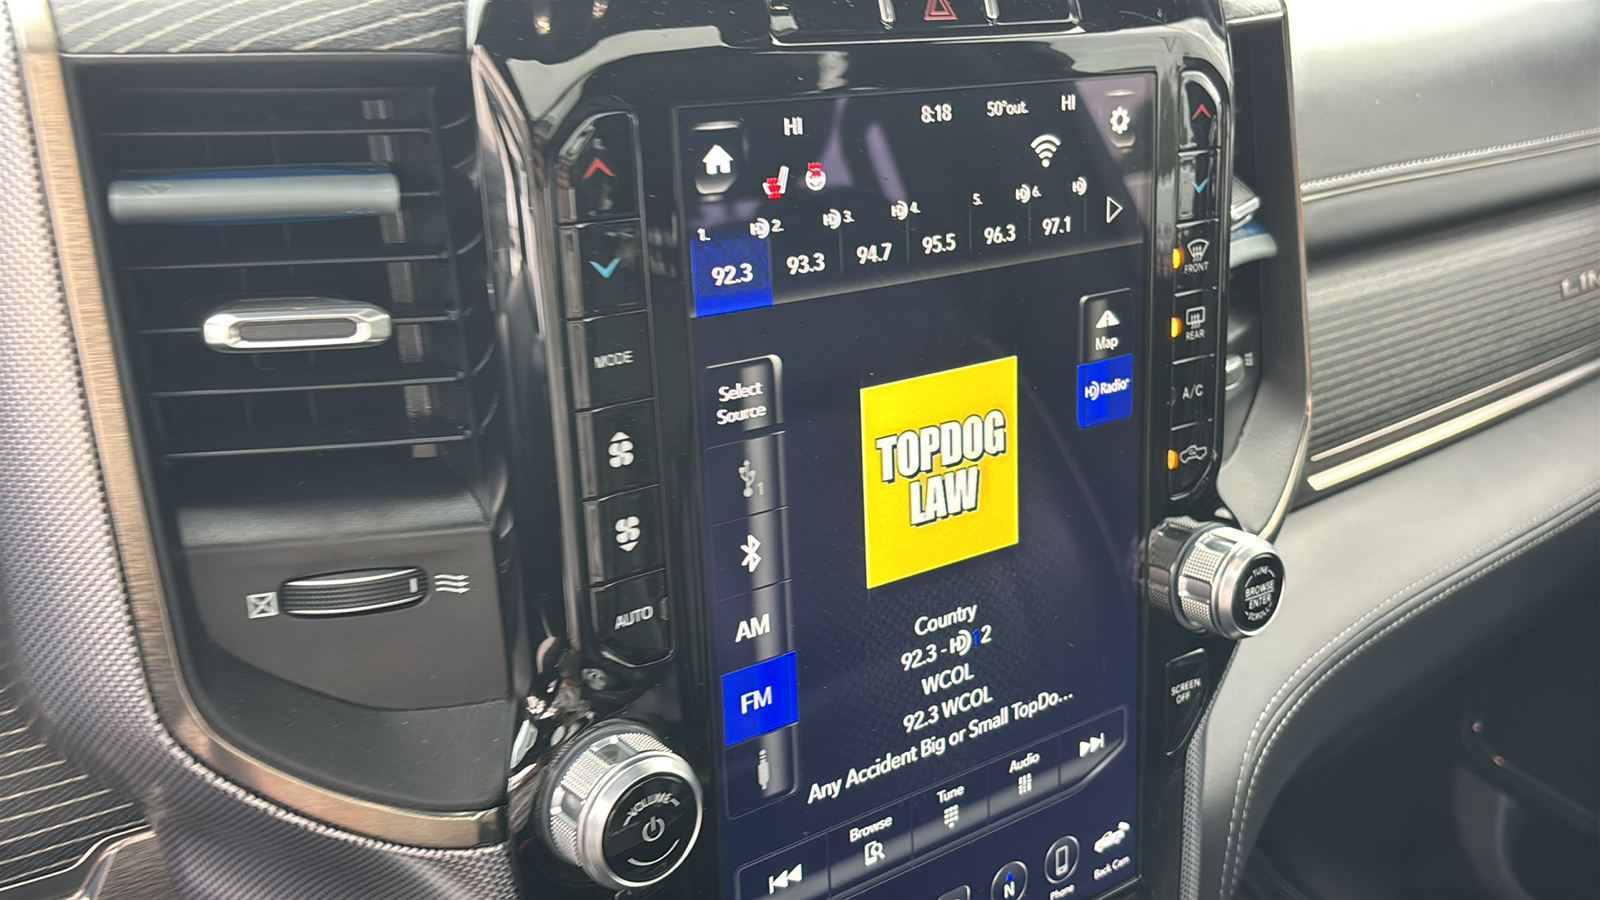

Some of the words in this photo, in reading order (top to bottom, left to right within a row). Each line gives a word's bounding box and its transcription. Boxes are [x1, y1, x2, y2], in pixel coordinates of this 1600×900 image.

[920, 103, 953, 125] 8:18
[1061, 94, 1076, 112] HI
[783, 116, 804, 136] HI
[983, 224, 1017, 246] 96.3
[1041, 215, 1073, 236] 97.1
[856, 242, 893, 265] 94.7
[921, 233, 957, 256] 95.5
[711, 262, 754, 287] 92.3
[786, 252, 826, 276] 93.3
[1184, 261, 1209, 275] FRONT
[1095, 336, 1119, 352] Map
[1185, 328, 1205, 342] REAR
[593, 350, 634, 369] MODE
[717, 382, 763, 403] Select
[1182, 383, 1204, 400] A/C
[716, 404, 767, 426] Source
[875, 409, 1007, 484] TOPDOG
[909, 464, 980, 528] LAW
[1252, 565, 1269, 578] TUNE
[1245, 579, 1275, 598] BROWSE
[1248, 593, 1272, 610] ENTER
[614, 605, 654, 631] AUTO
[914, 603, 978, 636] Country
[1247, 606, 1271, 622] SCROLL
[734, 613, 771, 643] AM
[900, 643, 938, 672] 92.3
[921, 662, 975, 696] WCOL
[1170, 677, 1201, 696] SCREEN
[740, 686, 773, 715] FM
[1176, 690, 1191, 705] OFF
[903, 704, 940, 734] 92.3
[942, 685, 993, 719] WCOL
[807, 777, 842, 804] Any
[845, 750, 918, 789] Accident
[919, 736, 946, 758] Big
[948, 727, 967, 746] or
[968, 705, 1008, 738] Small
[1010, 690, 1074, 721] TopDo...
[1008, 751, 1040, 774] Audio
[627, 791, 674, 817] VOLUME
[936, 784, 965, 804] Tune
[849, 815, 893, 843] Browse
[1093, 863, 1112, 880] Back
[1111, 855, 1131, 871] Cam
[1003, 880, 1015, 899] N
[1049, 883, 1076, 900] Phone
